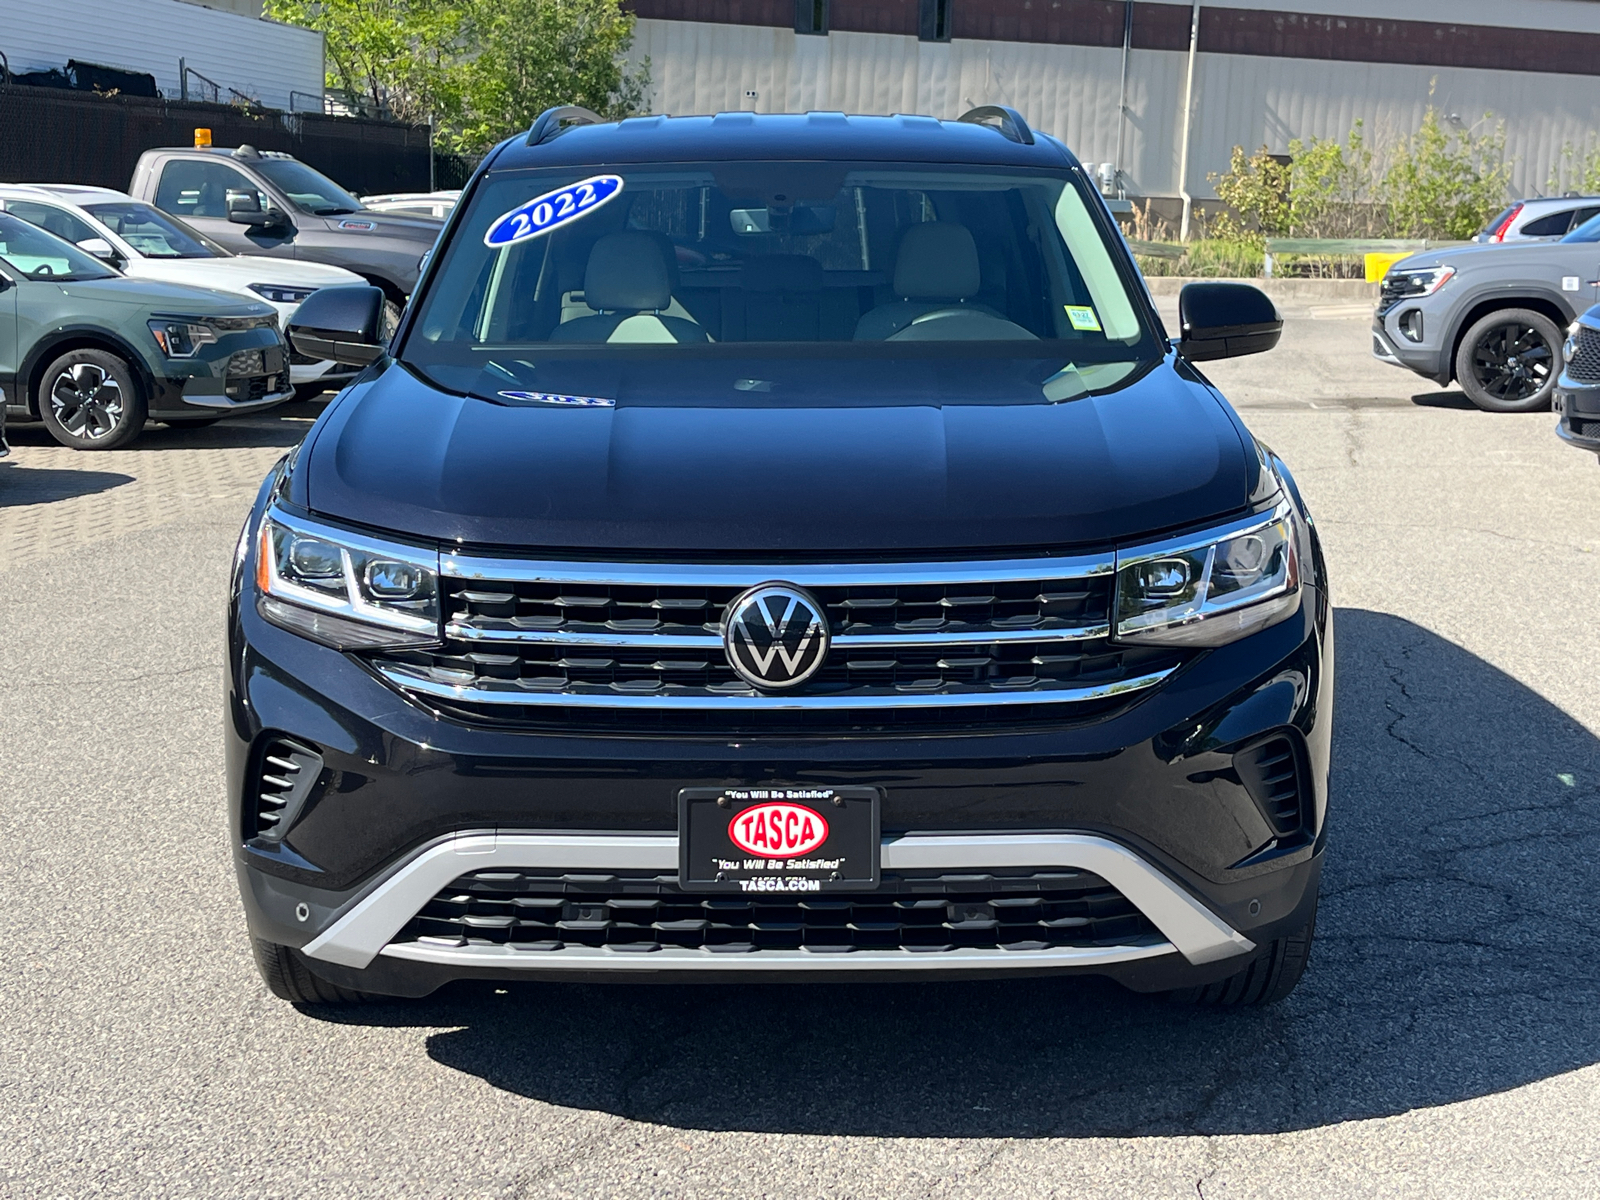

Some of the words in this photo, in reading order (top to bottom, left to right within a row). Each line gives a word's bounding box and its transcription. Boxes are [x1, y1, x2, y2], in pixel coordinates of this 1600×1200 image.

[510, 184, 597, 239] 2022
[750, 790, 769, 799] Will
[771, 790, 784, 799] Be
[741, 809, 815, 850] TASCA
[743, 859, 766, 870] Will
[767, 859, 784, 870] Be
[739, 880, 820, 892] TASCA.COM
